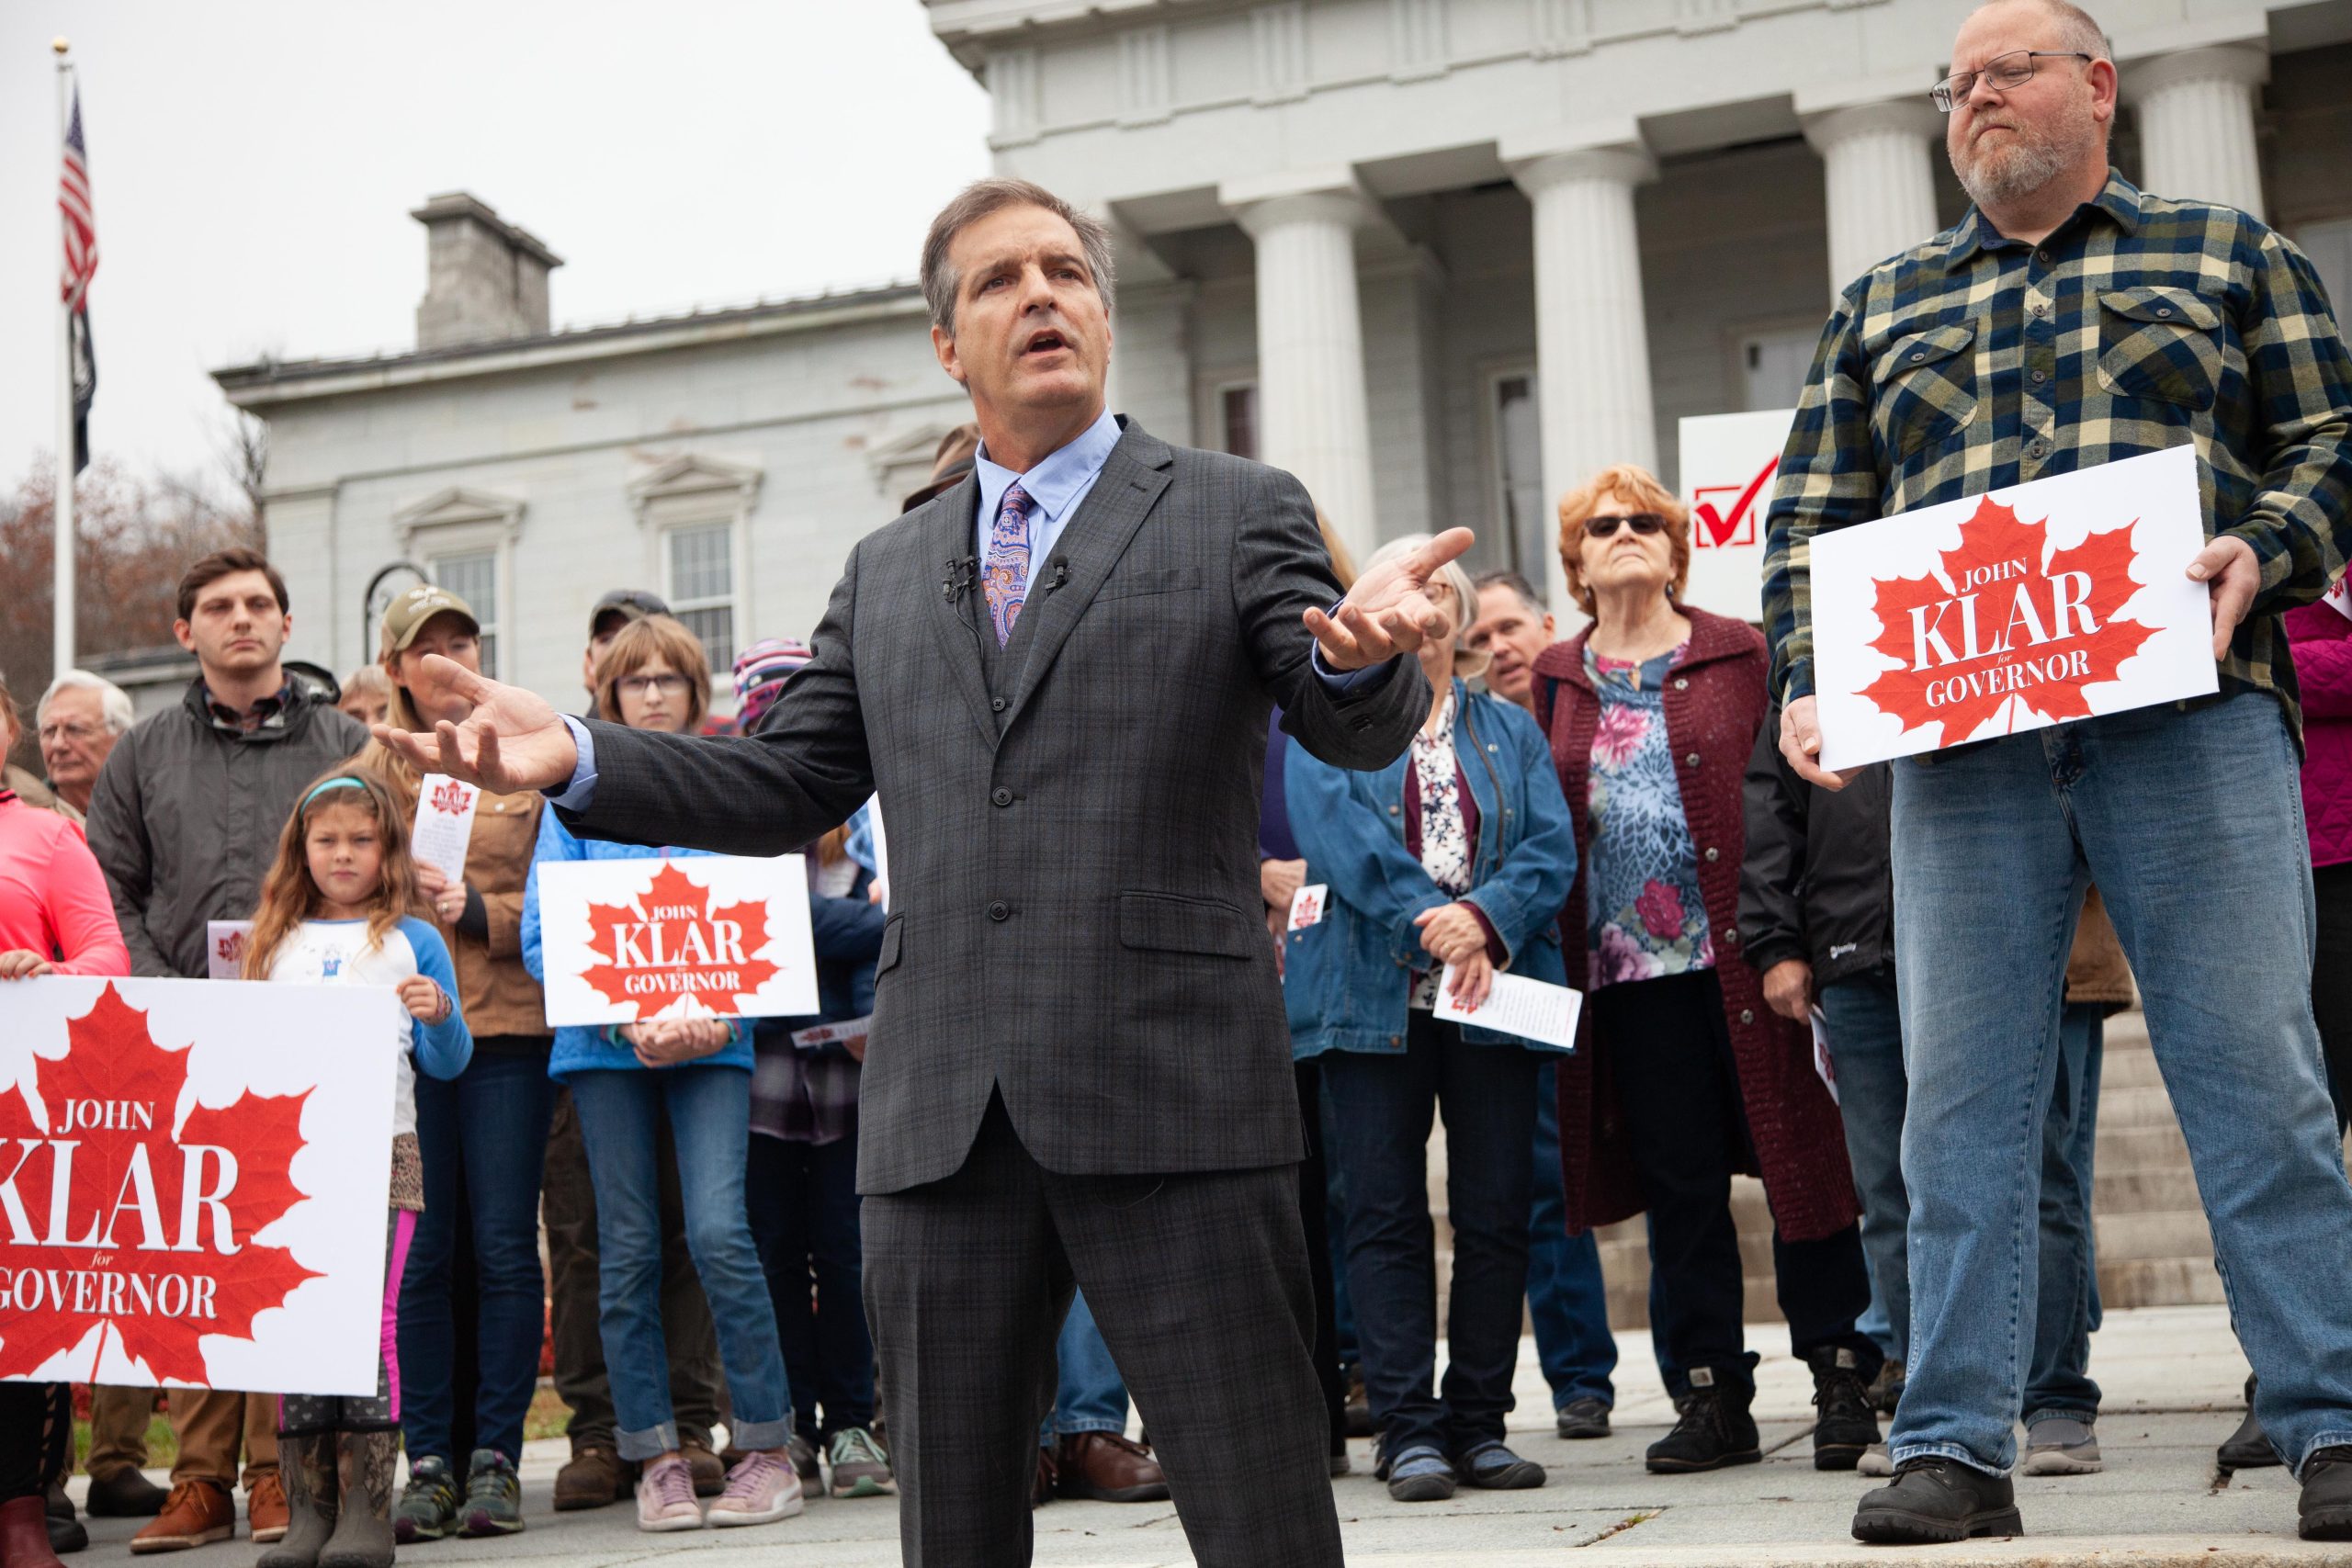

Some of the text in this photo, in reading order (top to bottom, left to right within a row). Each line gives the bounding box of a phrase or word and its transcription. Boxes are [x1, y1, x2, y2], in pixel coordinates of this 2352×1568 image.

[1962, 558, 2028, 592] JOHN
[1907, 570, 2101, 672] KLAR
[1996, 653, 2012, 666] for
[1927, 649, 2091, 707] GOVERNOR
[651, 905, 698, 921] JOHN
[612, 920, 748, 968] KLAR
[625, 971, 741, 993] GOVERNOR
[56, 1099, 155, 1134] JOHN
[0, 1138, 243, 1256] KLAR
[90, 1250, 114, 1269] for
